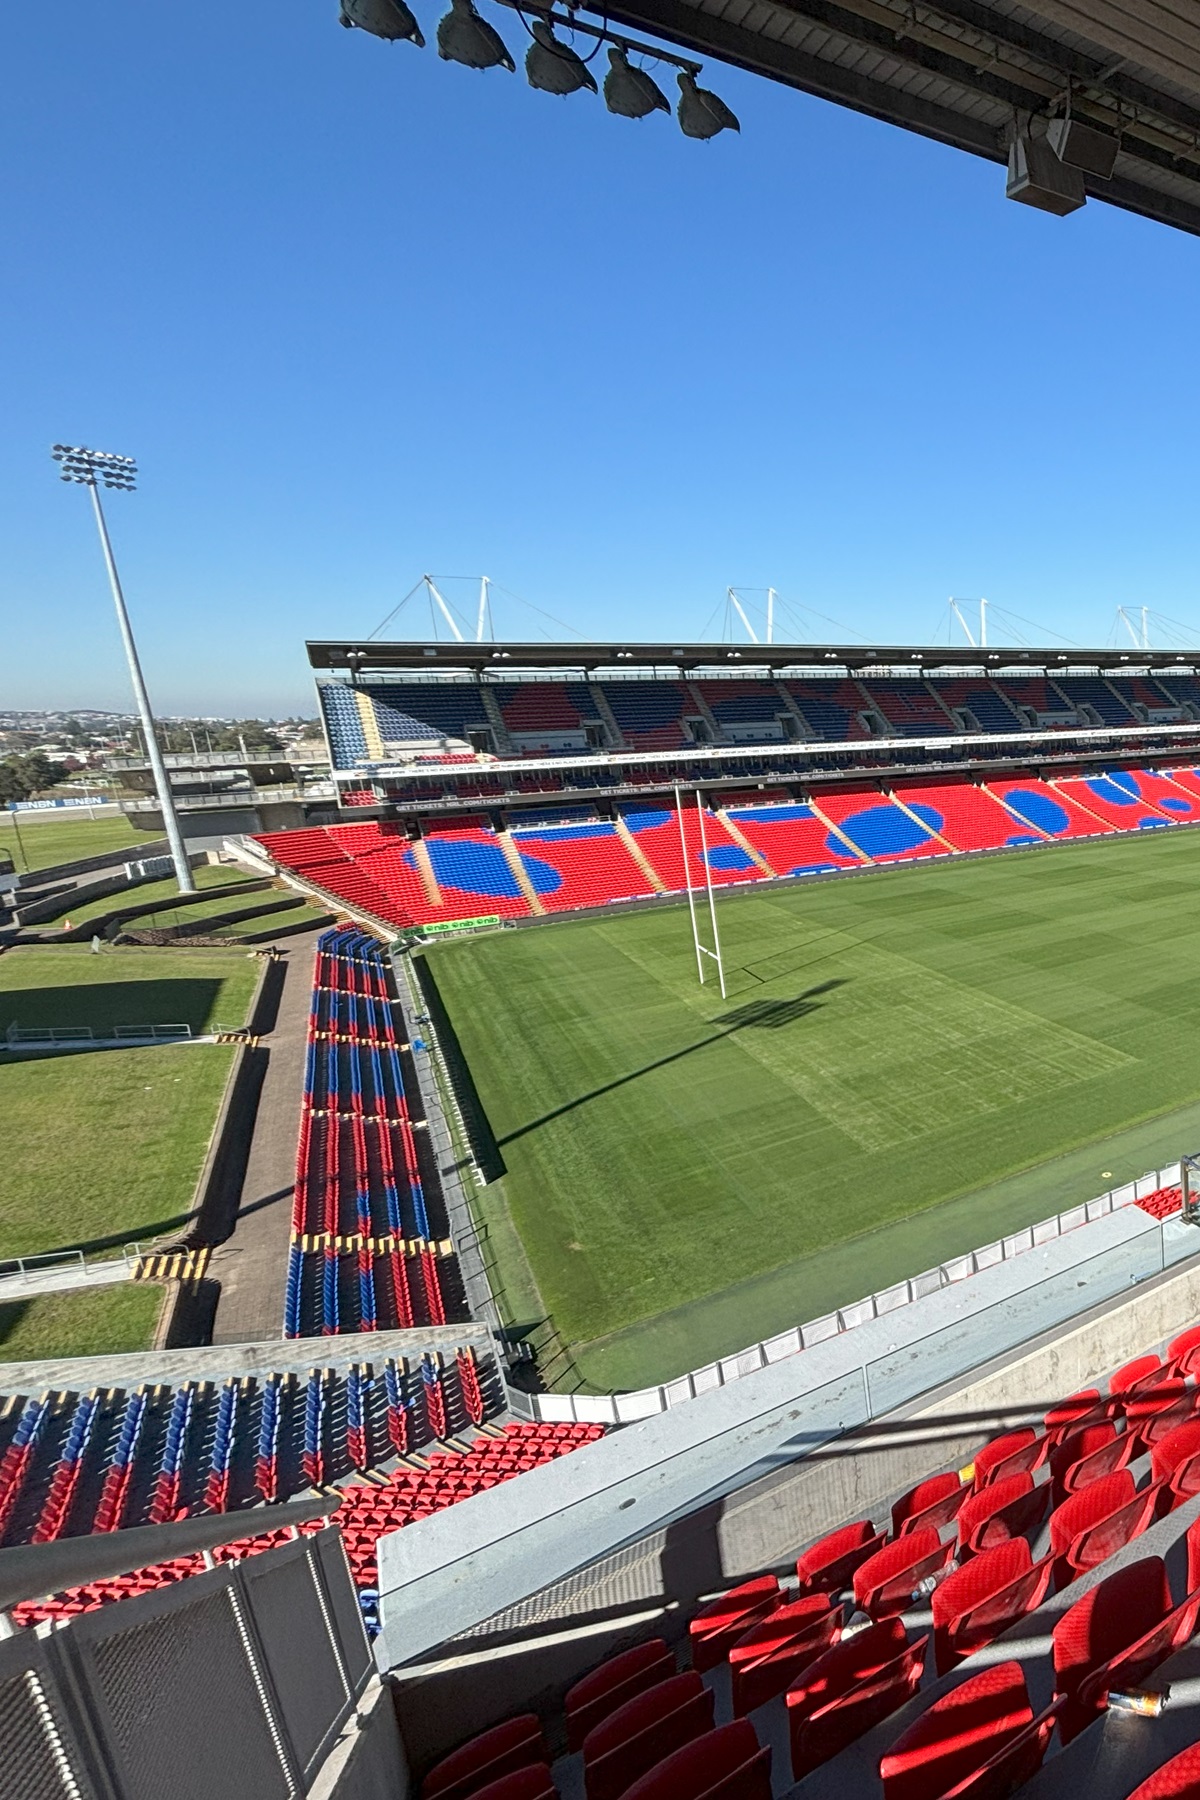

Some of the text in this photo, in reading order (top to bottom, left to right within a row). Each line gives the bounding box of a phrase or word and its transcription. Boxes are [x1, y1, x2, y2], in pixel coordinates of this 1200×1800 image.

[396, 804, 410, 812] GET
[412, 802, 445, 811] TICKETS:
[460, 919, 474, 927] nib
[484, 916, 498, 924] nib
[434, 923, 449, 931] nib
